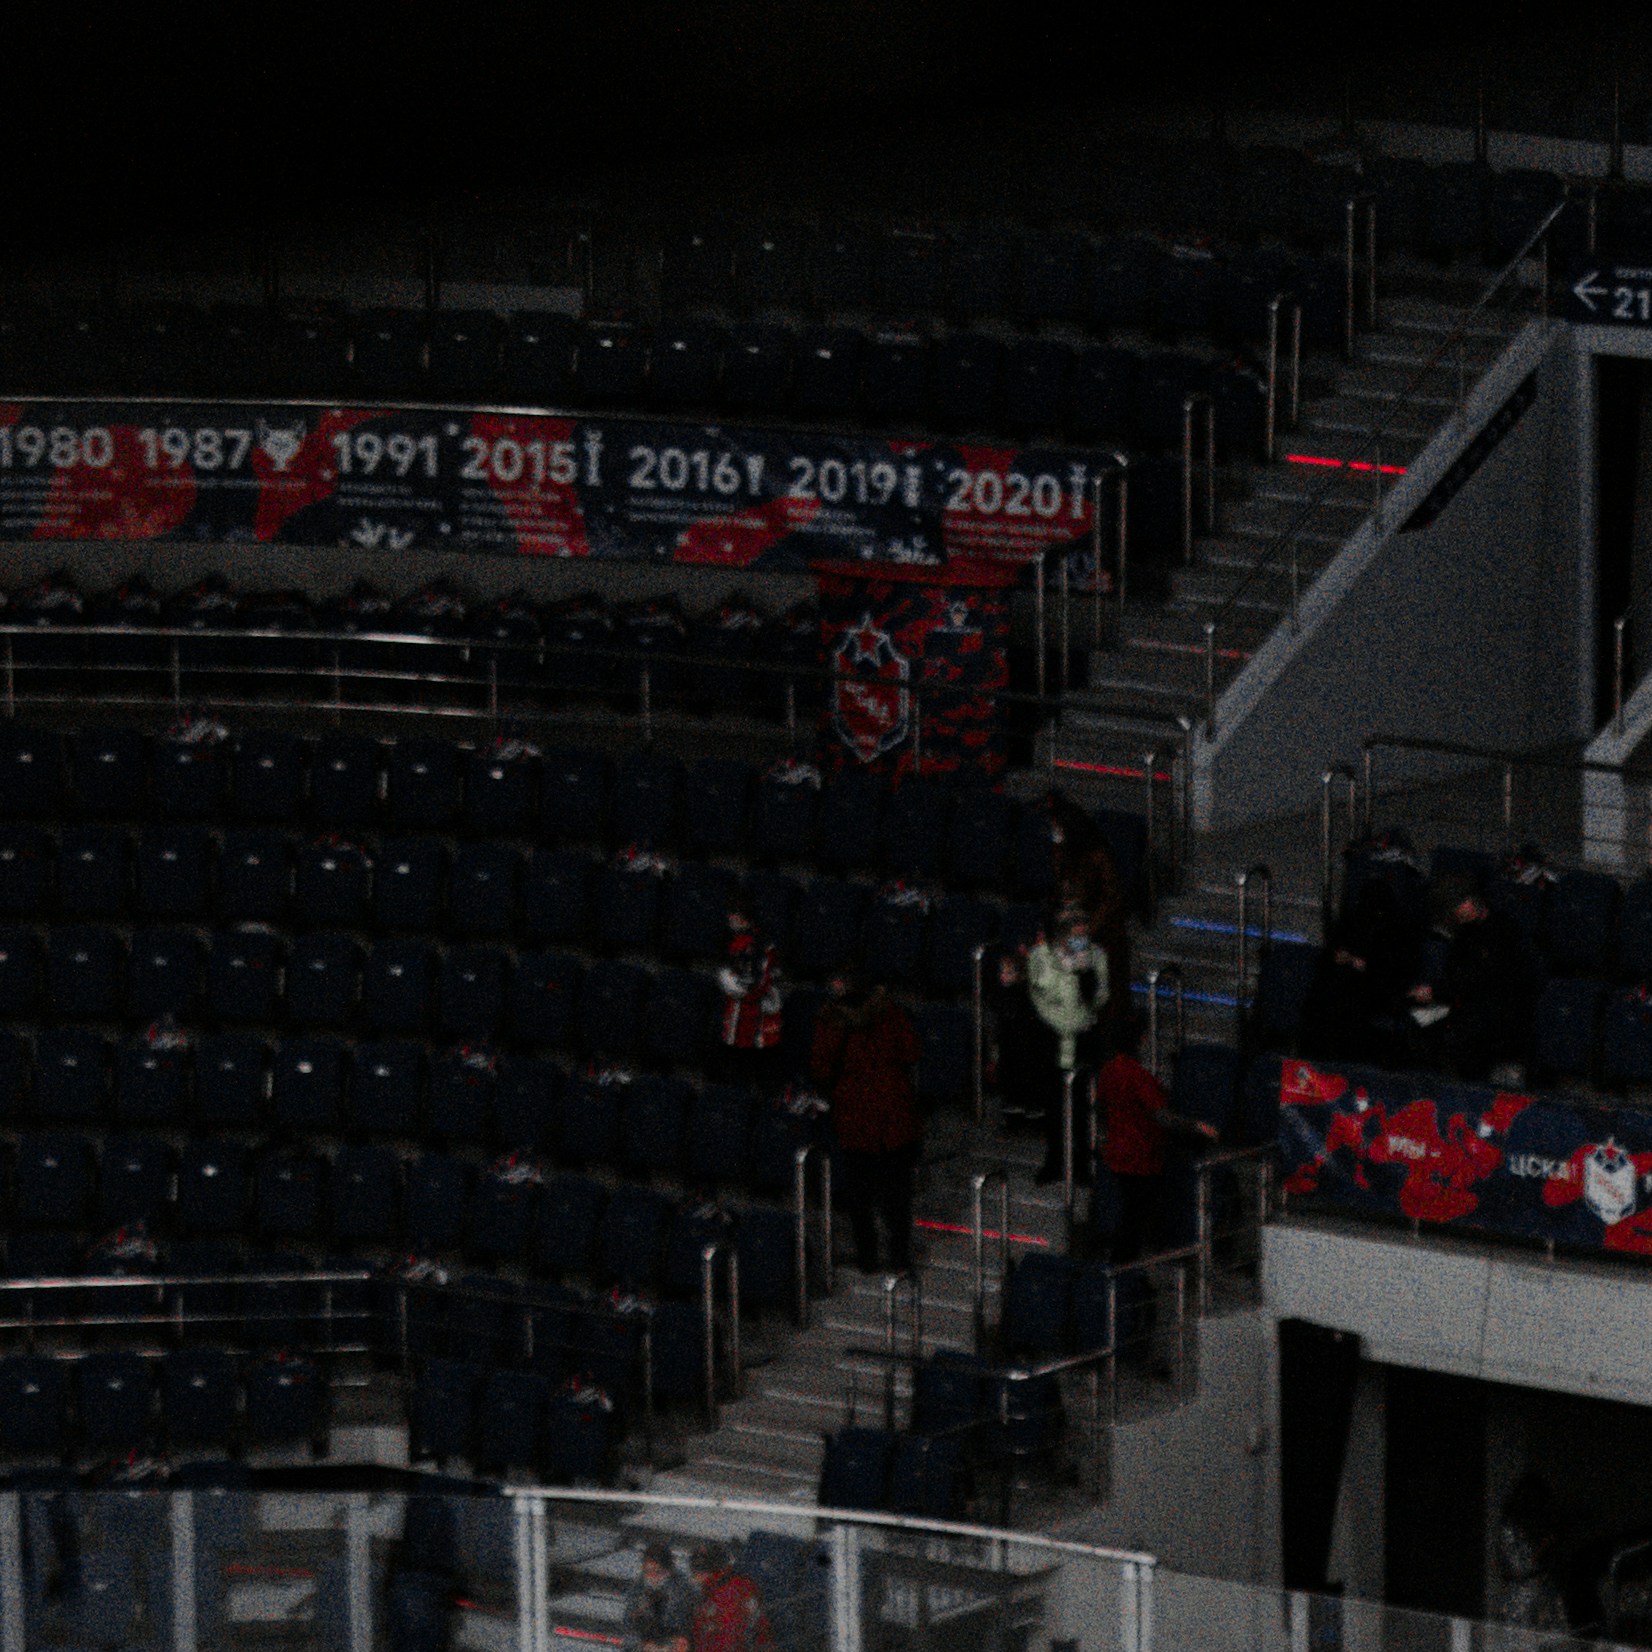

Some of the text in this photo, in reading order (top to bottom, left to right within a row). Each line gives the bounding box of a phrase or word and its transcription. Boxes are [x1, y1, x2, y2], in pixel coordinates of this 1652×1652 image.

[0, 426, 1062, 519] 1980 1987 1991 2015 2016 2019 2020
